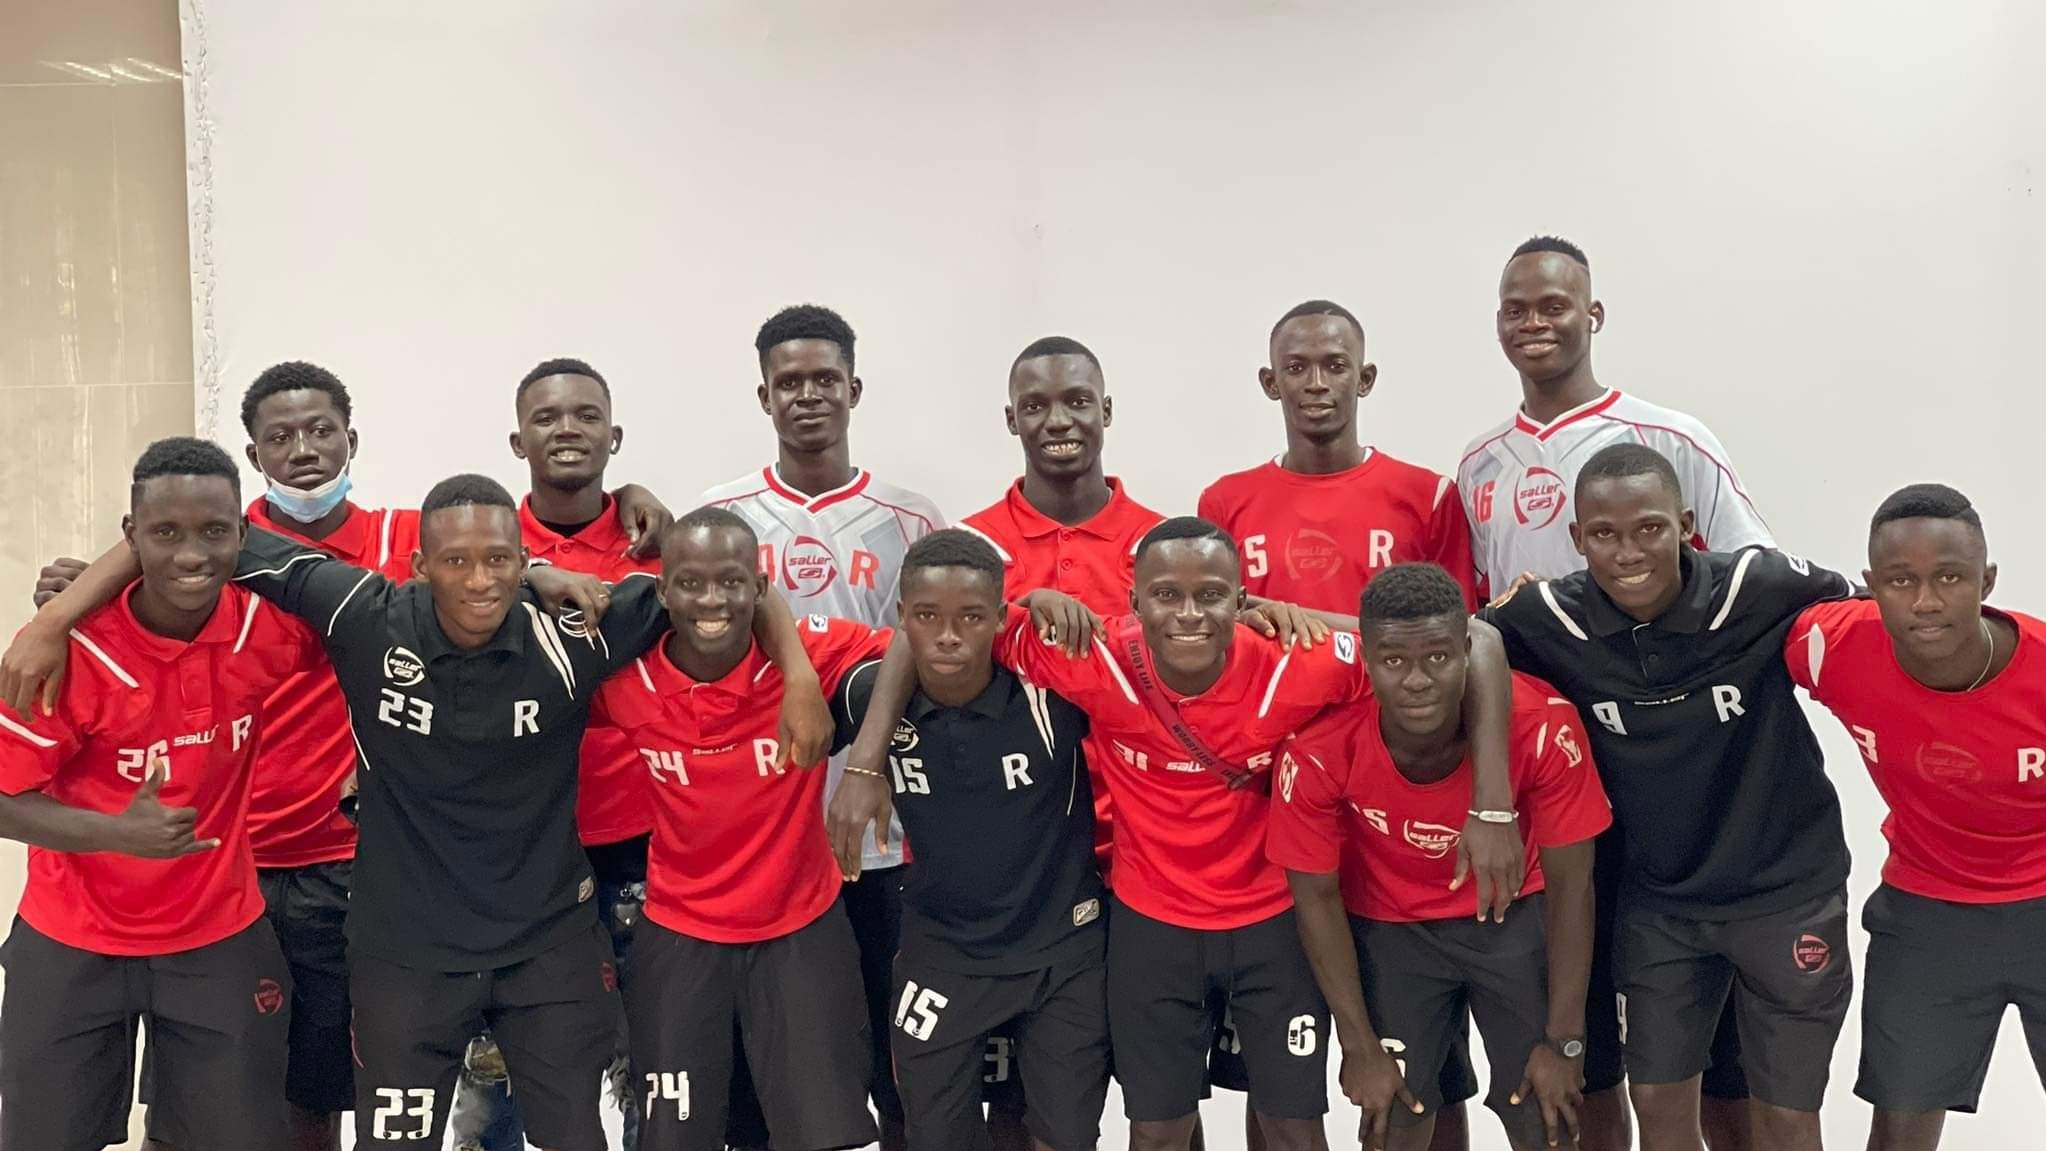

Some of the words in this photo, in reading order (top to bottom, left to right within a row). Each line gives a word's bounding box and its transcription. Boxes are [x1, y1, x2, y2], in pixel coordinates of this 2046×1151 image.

[789, 555, 832, 566] saller
[1369, 529, 1394, 568] R
[849, 550, 880, 592] R
[378, 688, 434, 736] 23
[513, 699, 540, 737] R
[1712, 684, 1746, 722] R
[232, 714, 252, 752] R
[752, 738, 786, 776] R
[889, 755, 931, 794] 15
[1001, 753, 1034, 790] R
[2017, 747, 2046, 783] R
[895, 980, 949, 1041] 15
[1287, 1014, 1316, 1056] 6
[373, 1087, 436, 1140] 23
[645, 1070, 690, 1121] 24
